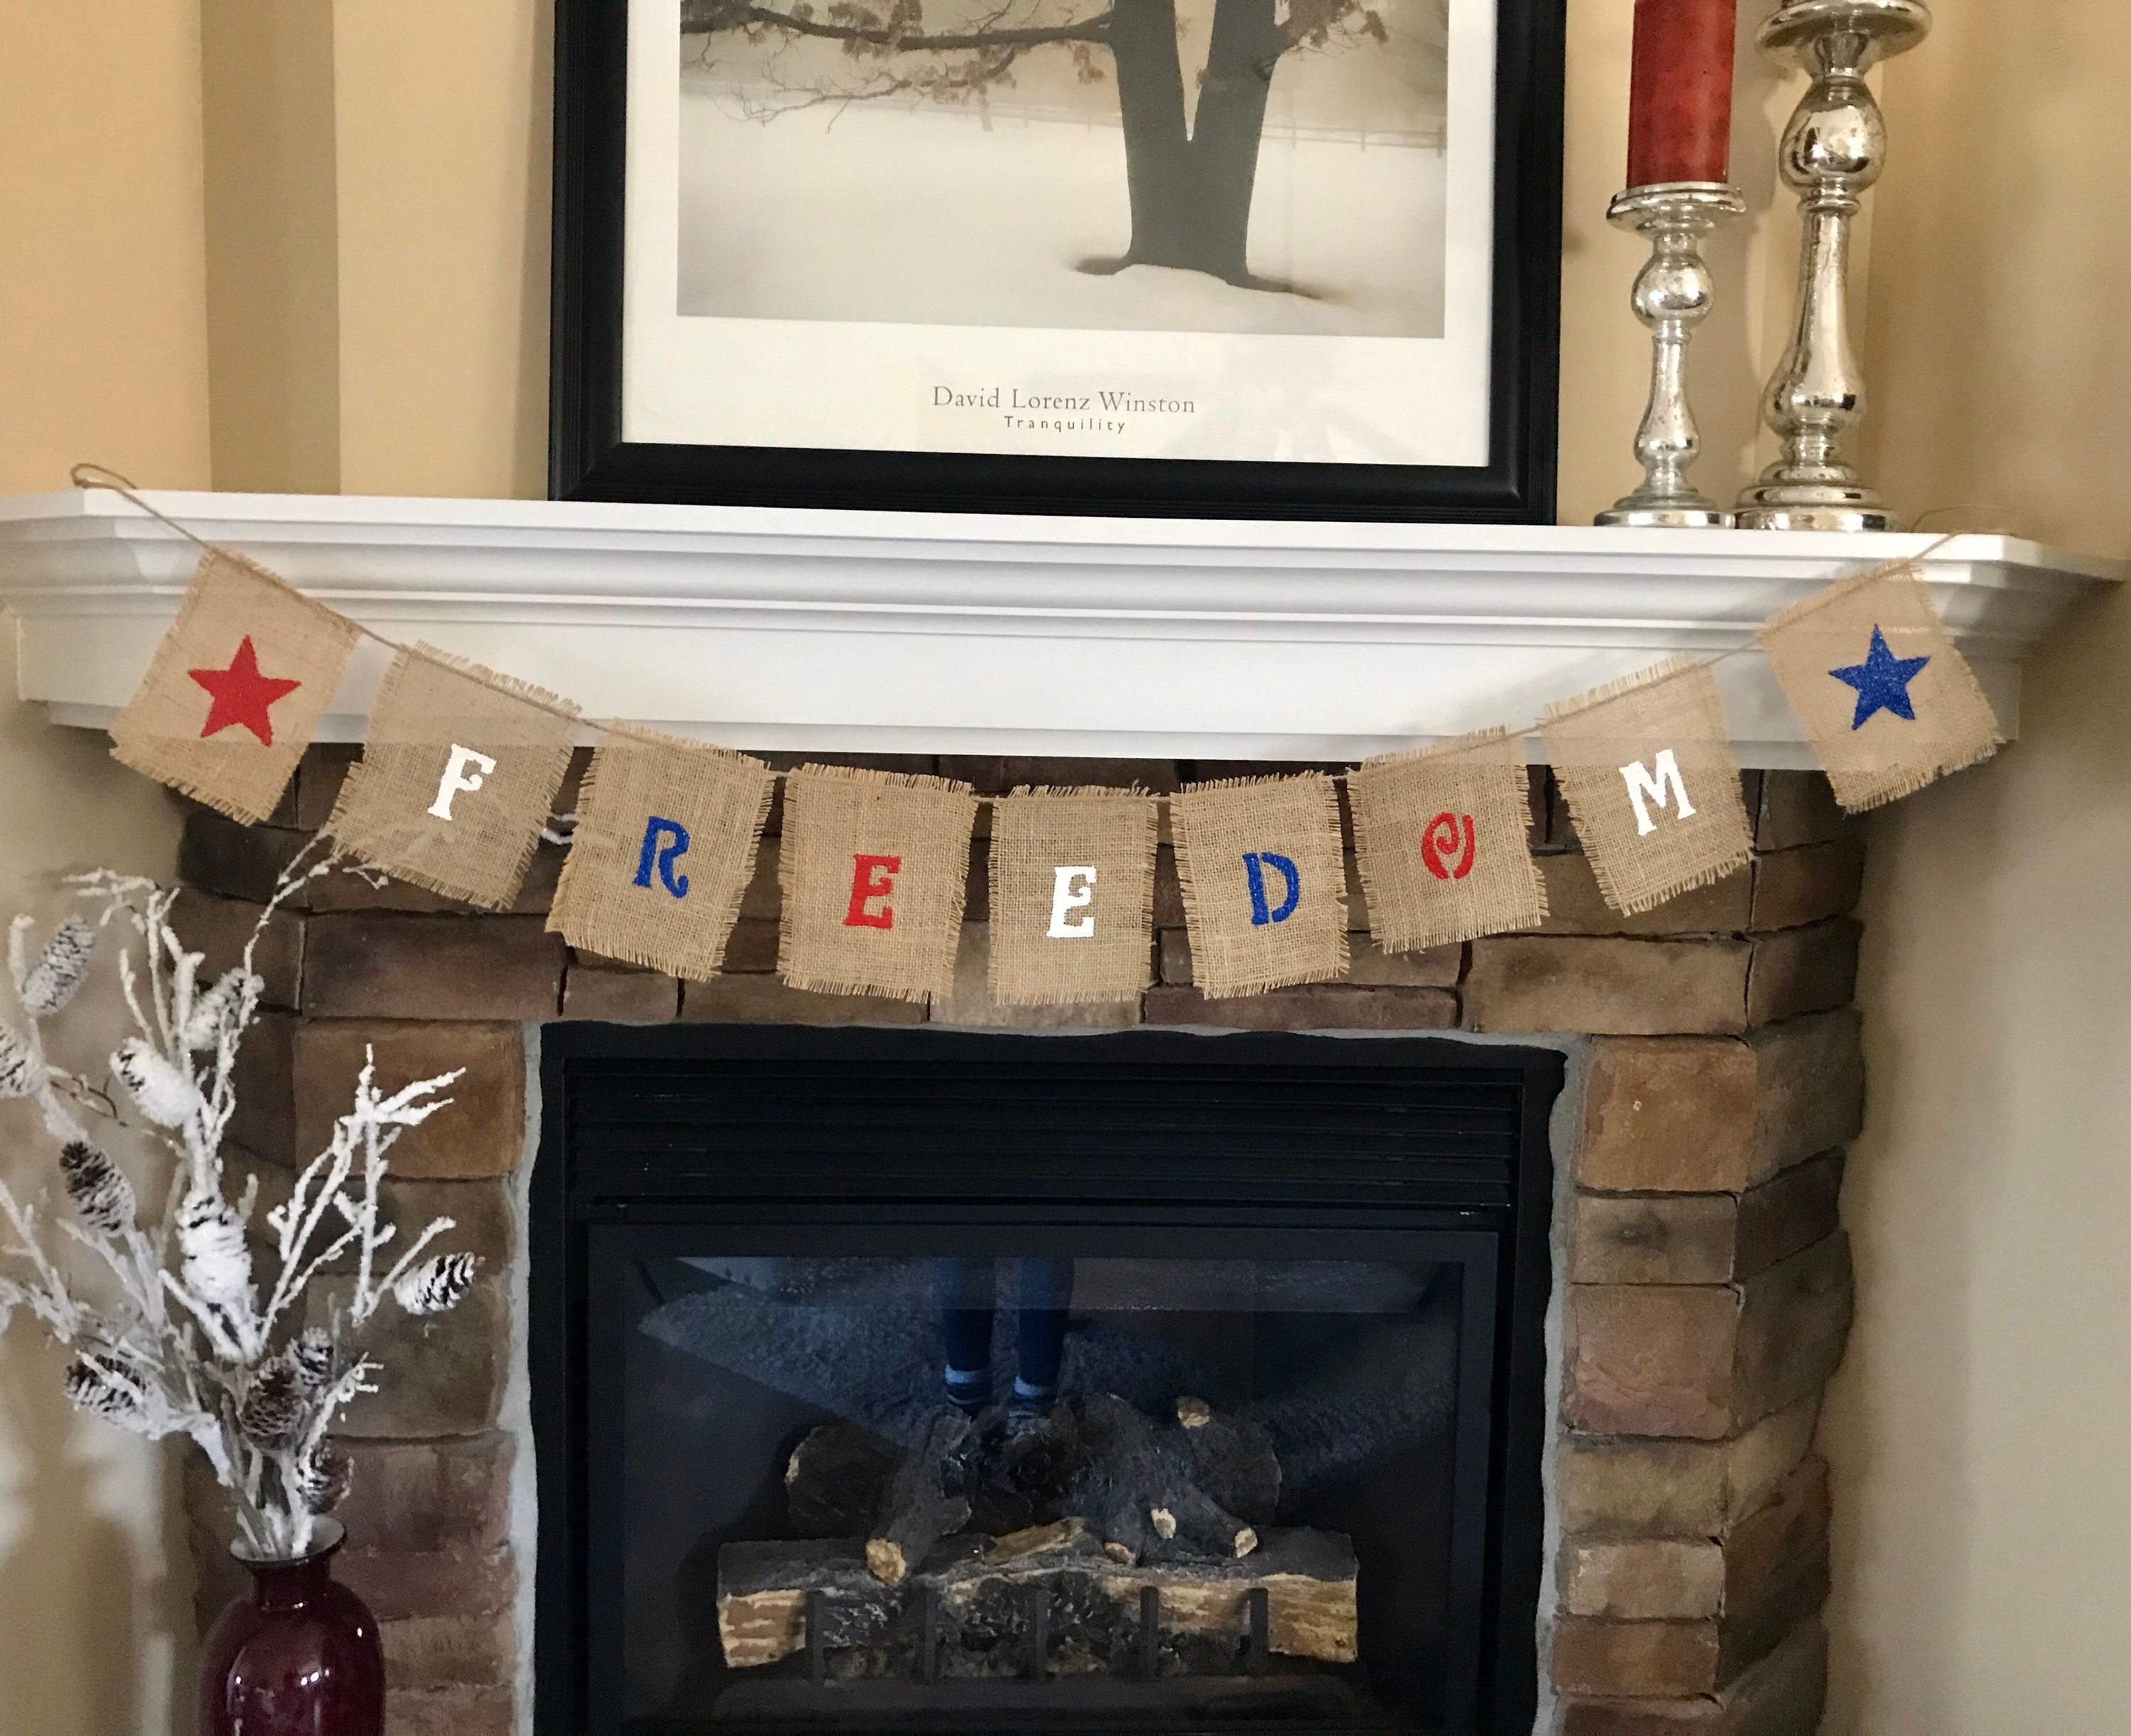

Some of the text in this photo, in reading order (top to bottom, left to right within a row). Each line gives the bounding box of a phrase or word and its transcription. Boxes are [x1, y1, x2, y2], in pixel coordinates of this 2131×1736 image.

[933, 386, 1196, 413] David Lorenz Winston
[1004, 416, 1126, 434] Tranquility
